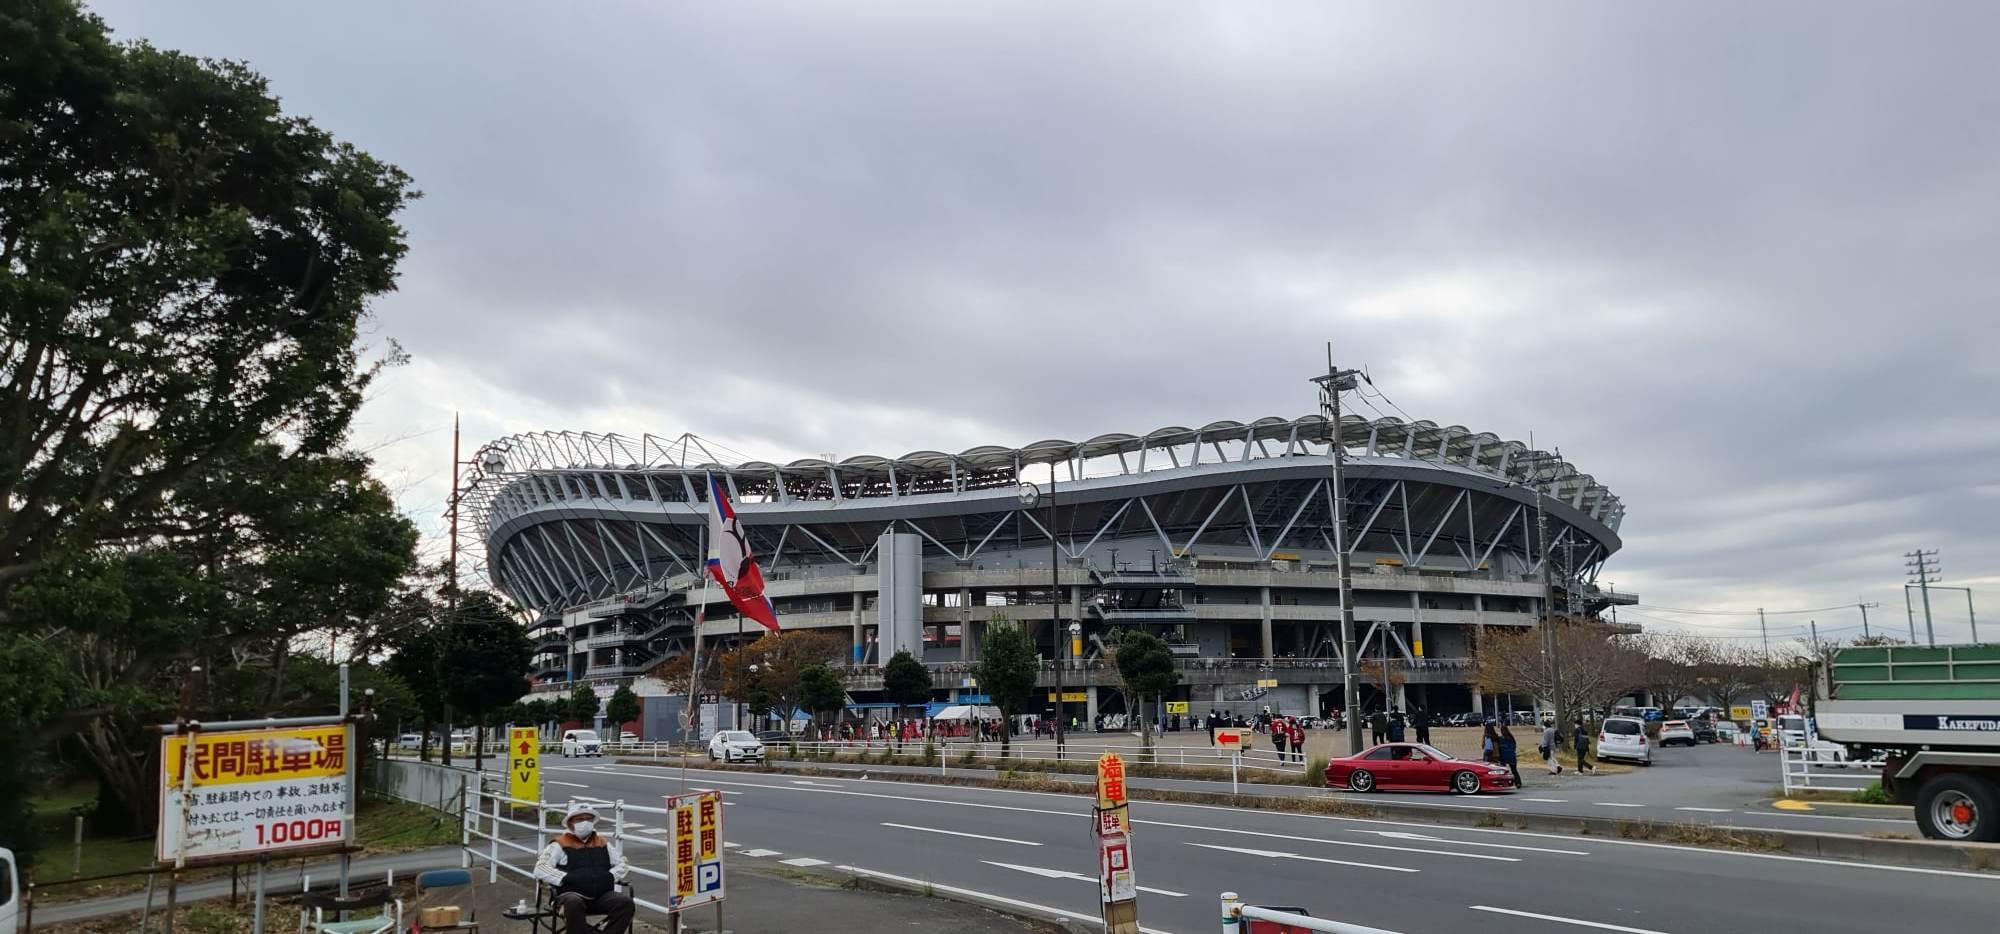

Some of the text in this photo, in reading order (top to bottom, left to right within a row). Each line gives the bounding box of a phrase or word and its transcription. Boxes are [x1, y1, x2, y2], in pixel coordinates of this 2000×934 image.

[514, 758, 535, 769] FG
[520, 772, 530, 783] V
[1101, 756, 1125, 801] 満車
[700, 800, 716, 857] 民間
[677, 810, 693, 892] 駐車場
[700, 863, 719, 892] P
